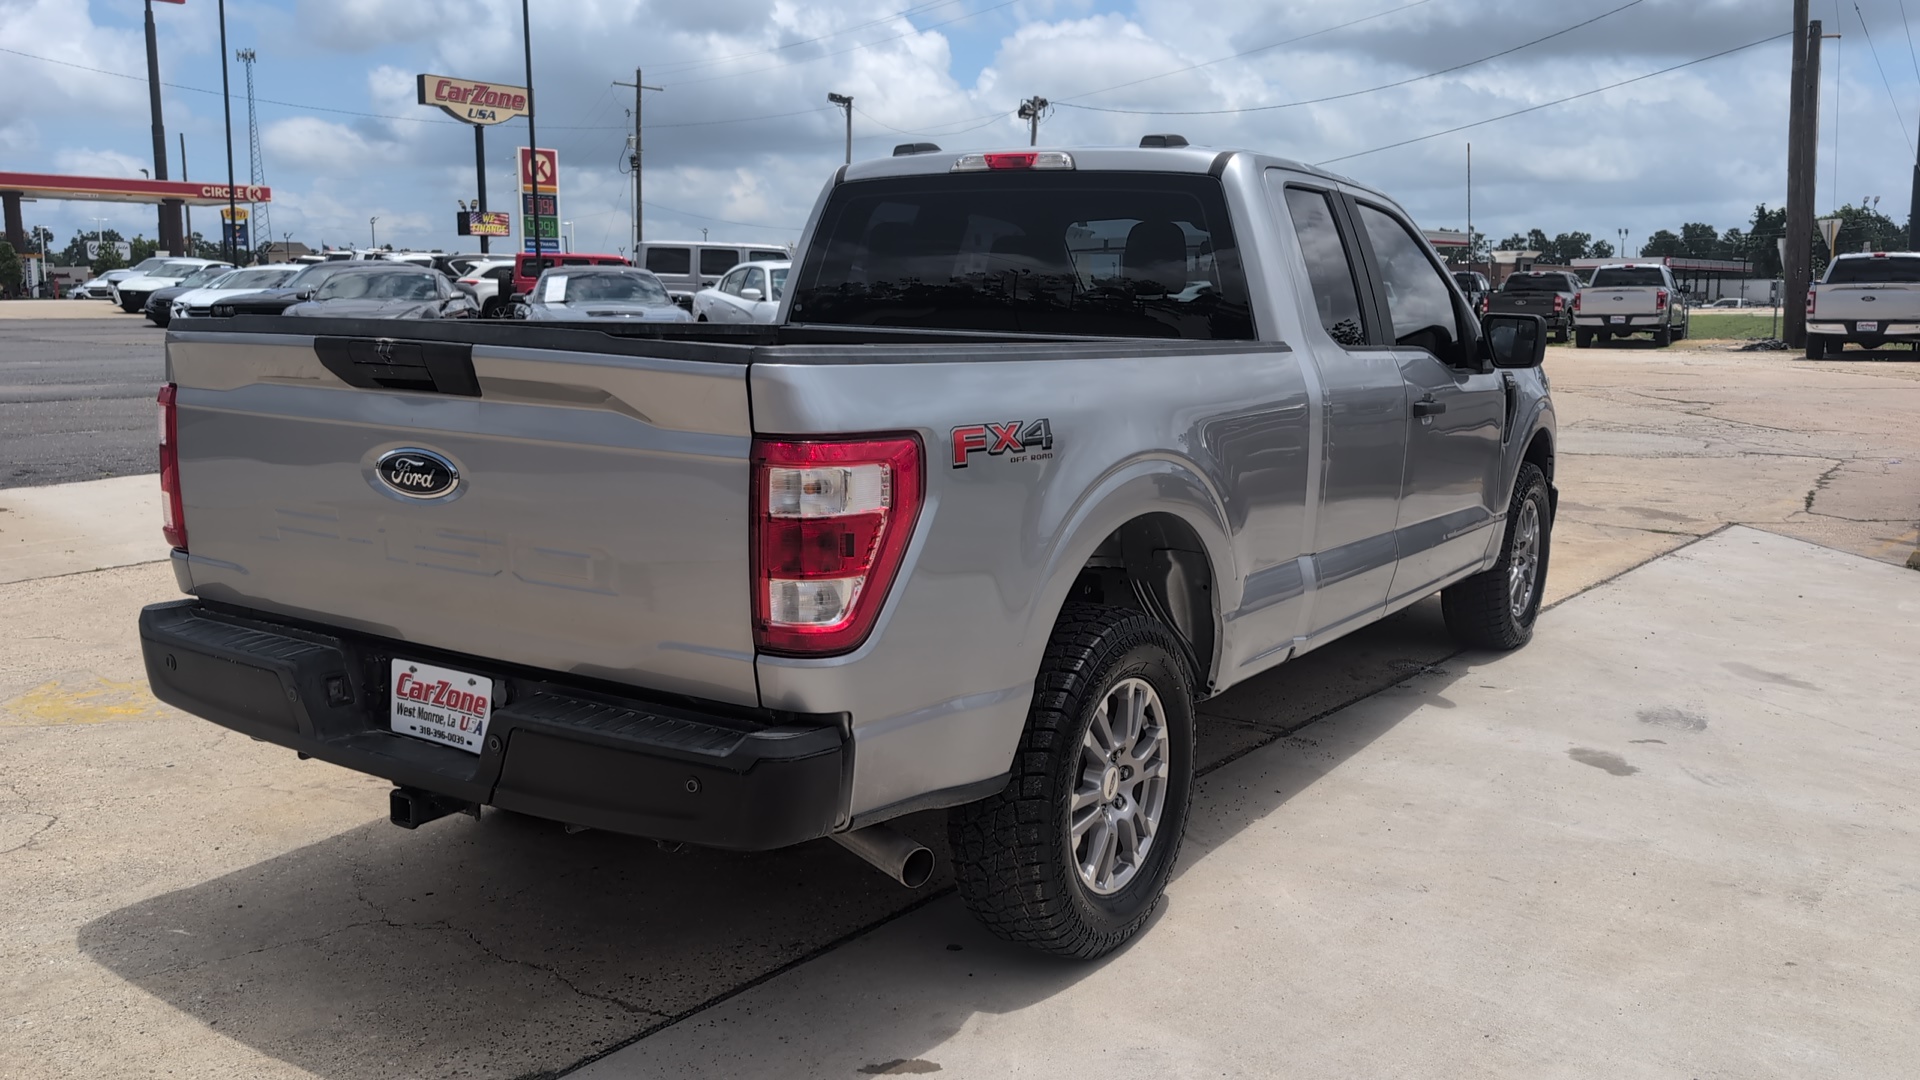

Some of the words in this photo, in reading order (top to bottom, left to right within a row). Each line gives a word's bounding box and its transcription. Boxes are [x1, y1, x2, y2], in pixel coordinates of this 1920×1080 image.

[435, 79, 526, 111] CarZone
[467, 107, 496, 121] USA
[202, 186, 244, 198] CIRCE
[250, 187, 260, 201] K
[472, 223, 507, 233] FINANCE
[950, 418, 1053, 469] FX4
[1010, 455, 1028, 463] OFF
[1031, 453, 1053, 461] ROAD
[391, 457, 435, 488] Ford
[396, 672, 488, 719] CarZone
[397, 702, 417, 718] West
[417, 706, 446, 728] Monroe,
[447, 713, 456, 728] La
[419, 725, 465, 745] 318-396-0039
